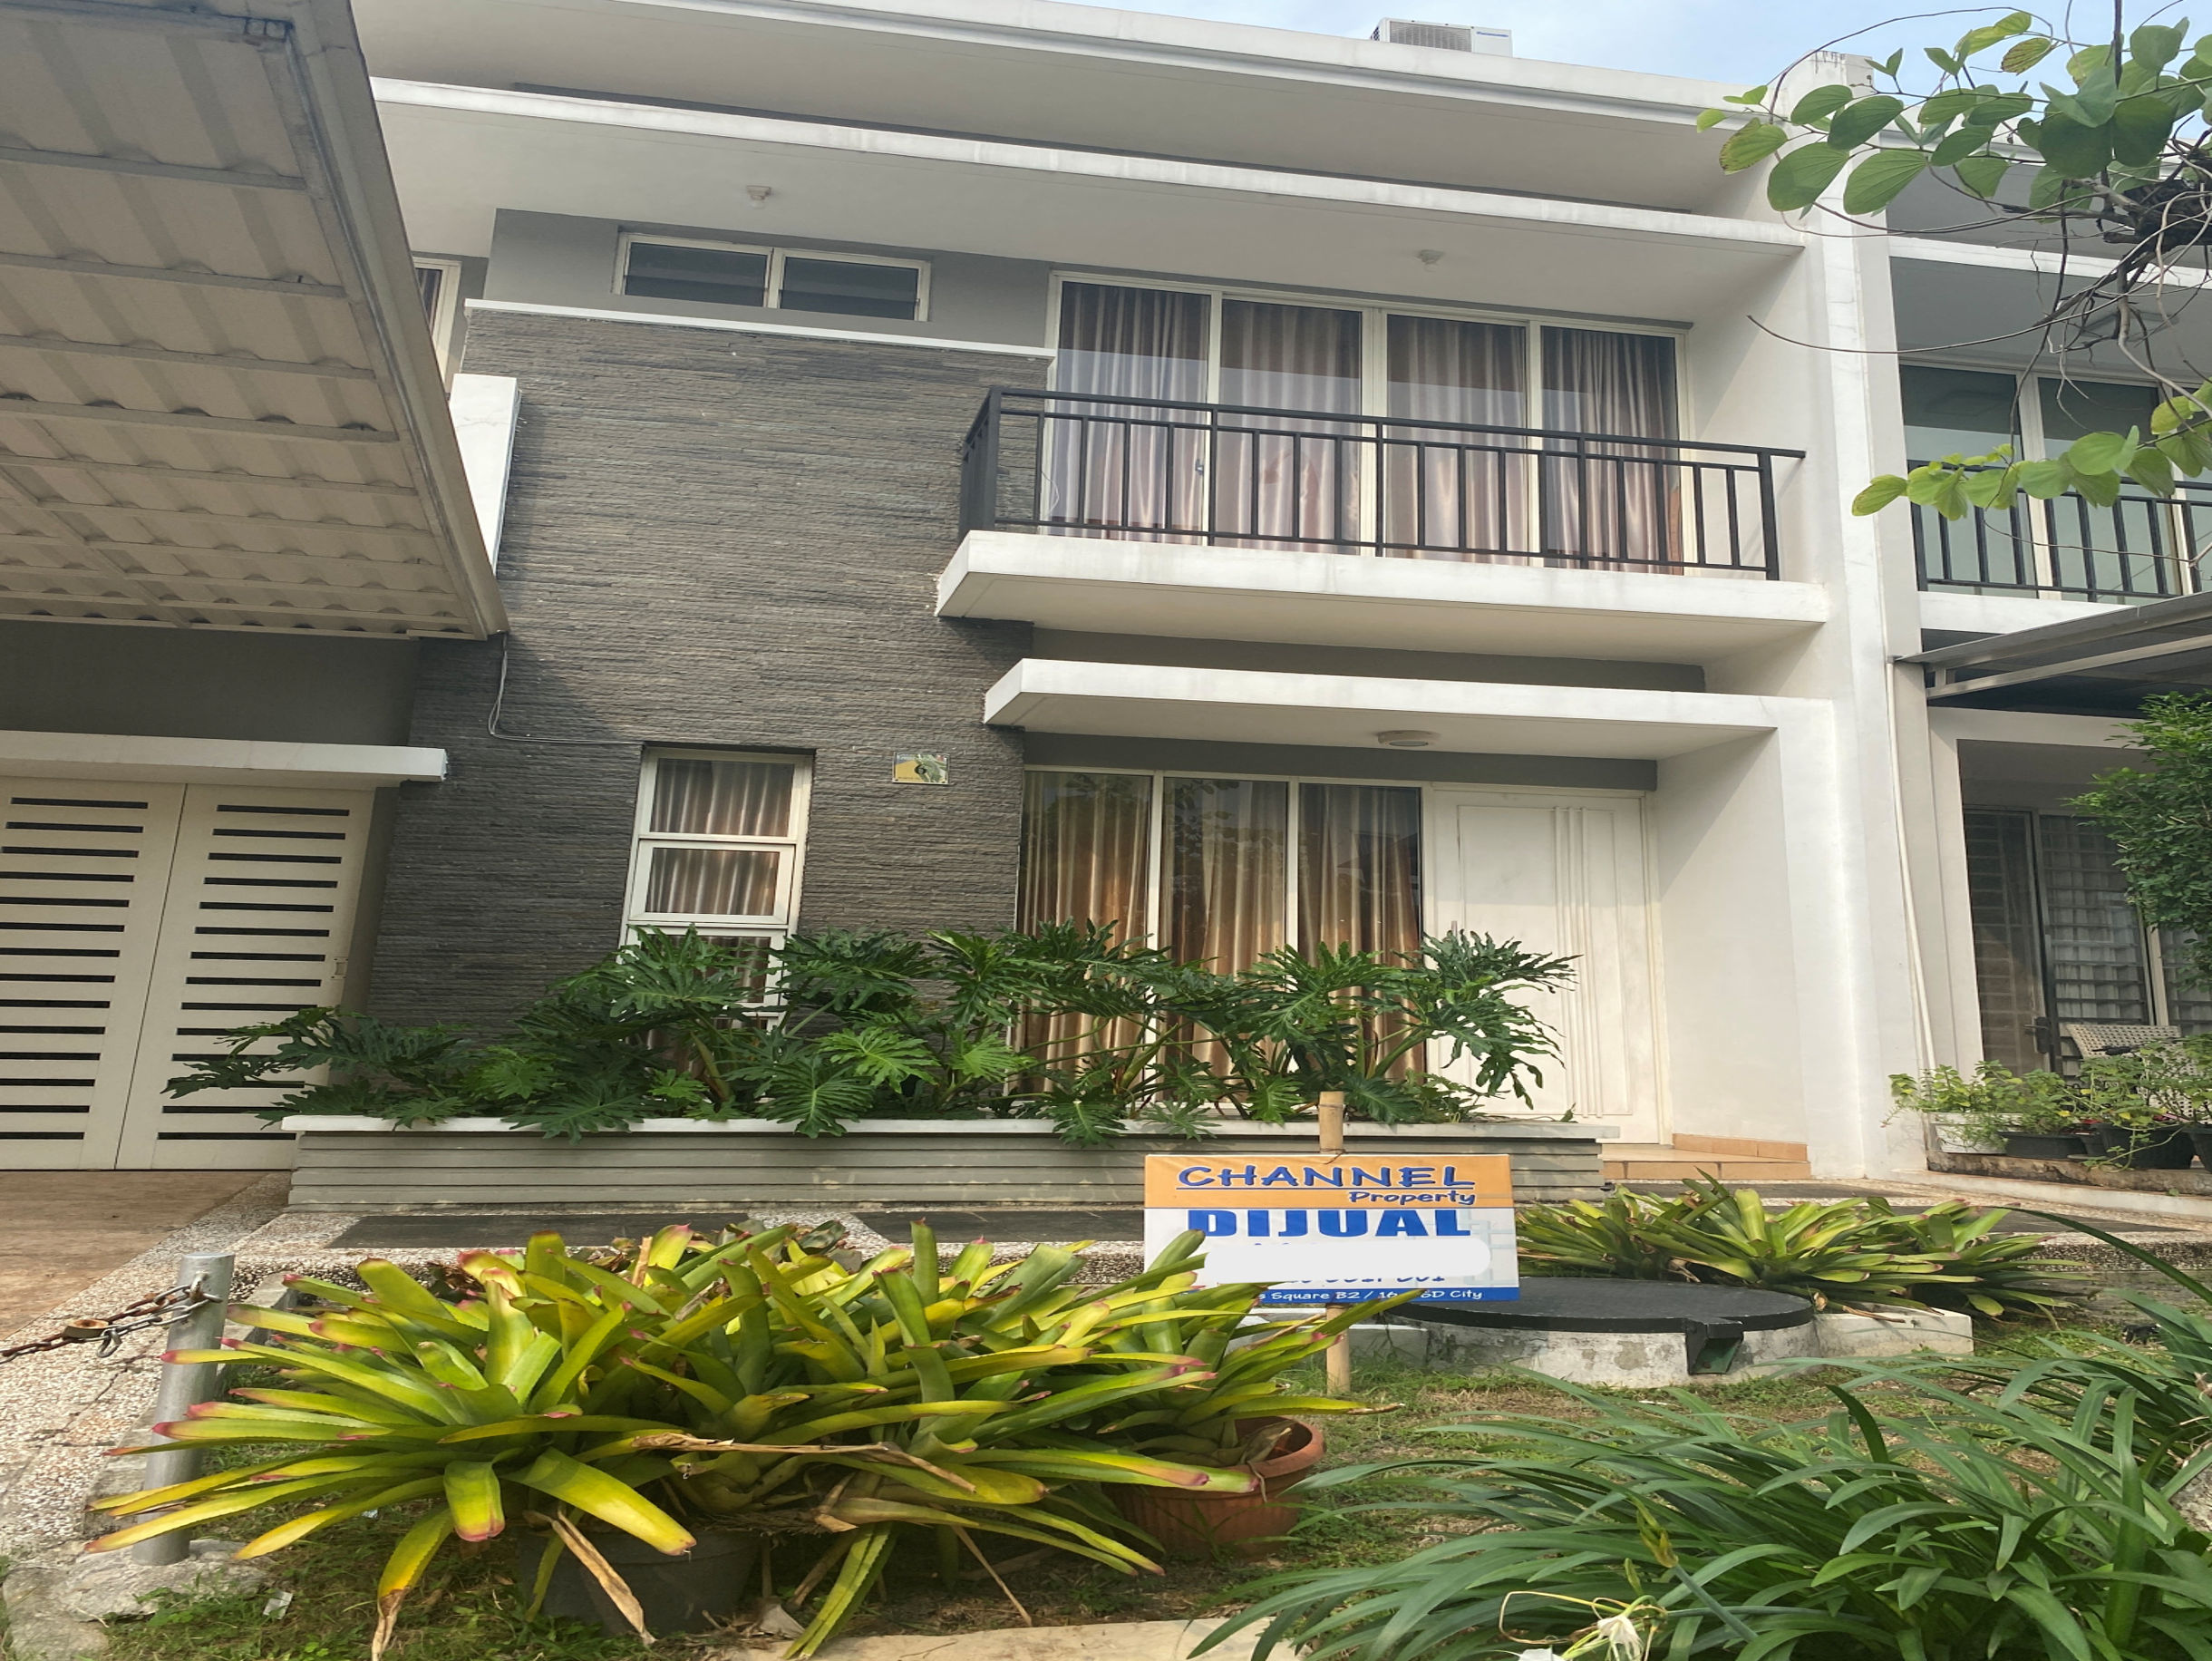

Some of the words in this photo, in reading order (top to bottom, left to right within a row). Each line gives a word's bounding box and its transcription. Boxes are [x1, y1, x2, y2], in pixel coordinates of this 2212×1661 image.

[1178, 1164, 1476, 1187] CHANNEL
[1349, 1190, 1476, 1206] Property
[1188, 1209, 1470, 1238] DIJUAL
[1271, 1292, 1330, 1301] Square
[1335, 1291, 1360, 1299] B2
[1450, 1289, 1483, 1300] City
